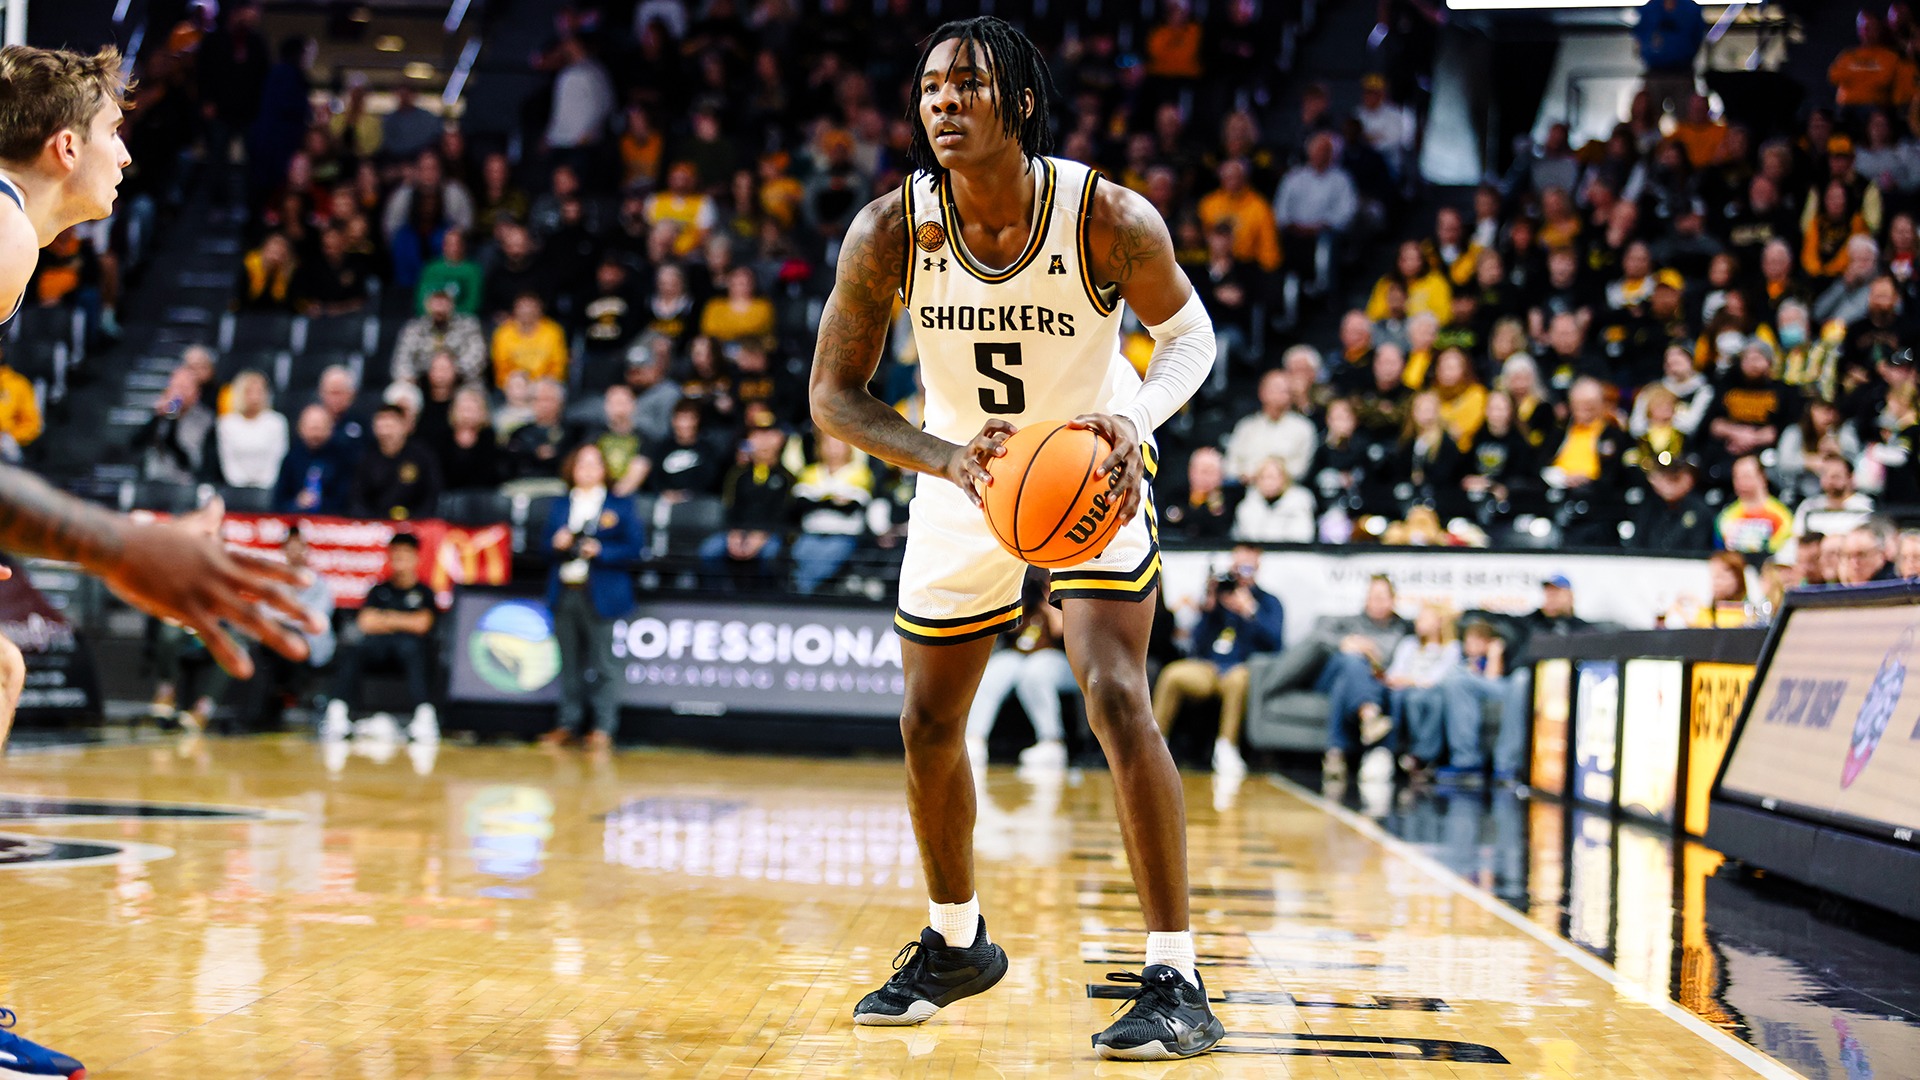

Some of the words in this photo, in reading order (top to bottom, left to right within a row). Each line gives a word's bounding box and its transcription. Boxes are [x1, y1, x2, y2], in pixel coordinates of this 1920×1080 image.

[920, 305, 1076, 337] SHOCKERS
[973, 342, 1026, 414] 5
[1064, 459, 1127, 544] Wilon
[612, 617, 904, 668] OFESSIONA
[625, 663, 774, 689] DSCAPING
[784, 669, 904, 695] SERVICE
